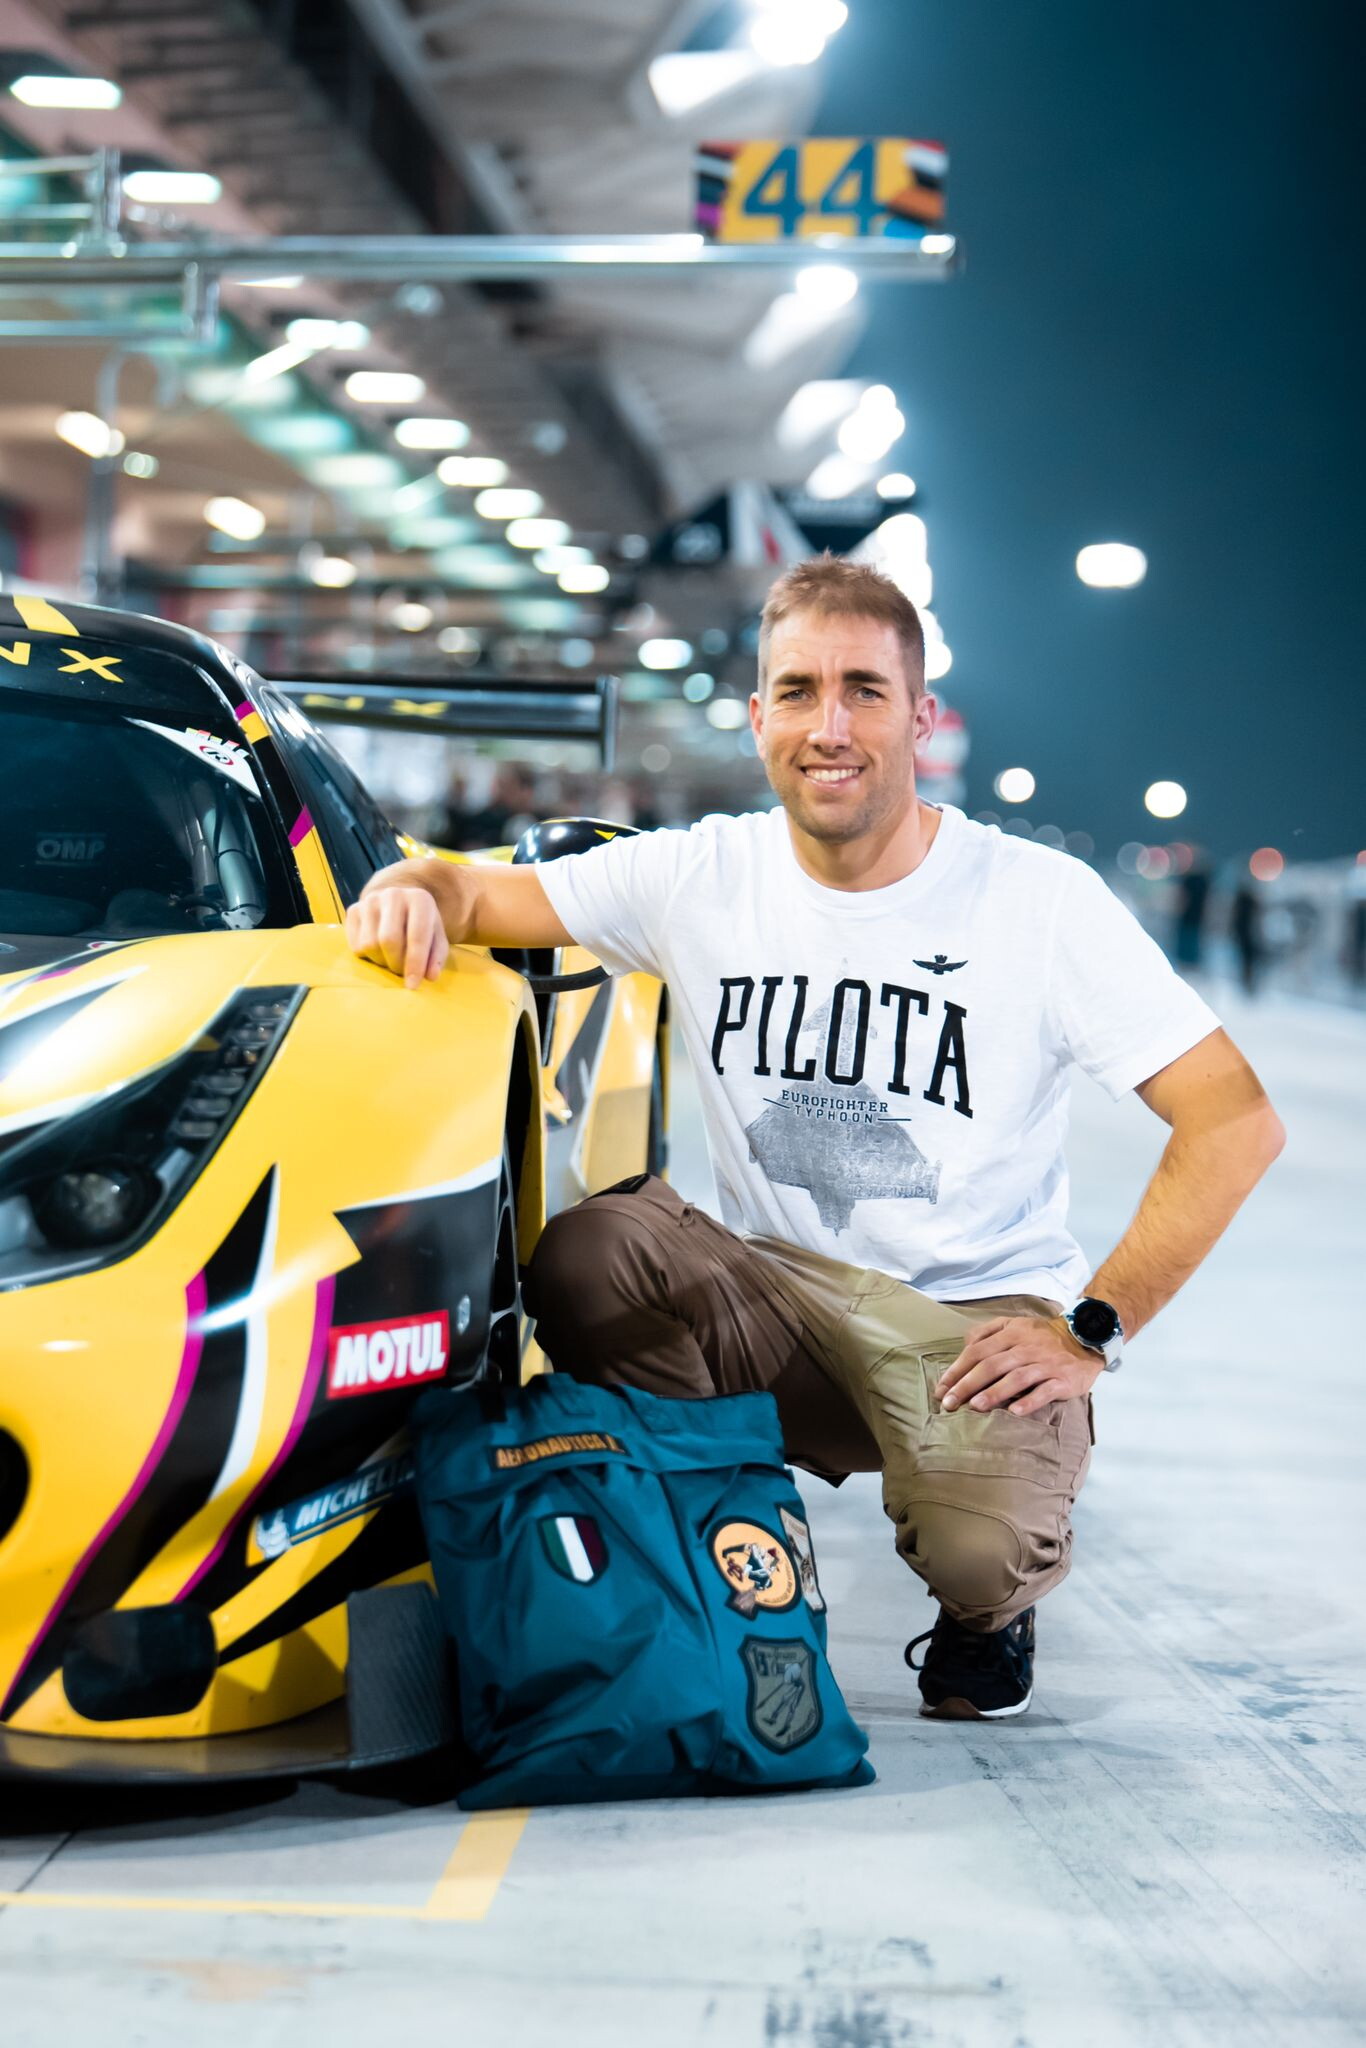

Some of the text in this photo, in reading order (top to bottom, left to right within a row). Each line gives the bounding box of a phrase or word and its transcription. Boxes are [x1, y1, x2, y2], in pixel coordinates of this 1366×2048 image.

[743, 143, 888, 236] 44
[36, 839, 105, 860] OMP
[711, 975, 974, 1119] PILOTA
[782, 1089, 889, 1113] EUROFIGHTER
[795, 1105, 874, 1123] TYPHOON
[331, 1321, 446, 1388] MOTUL
